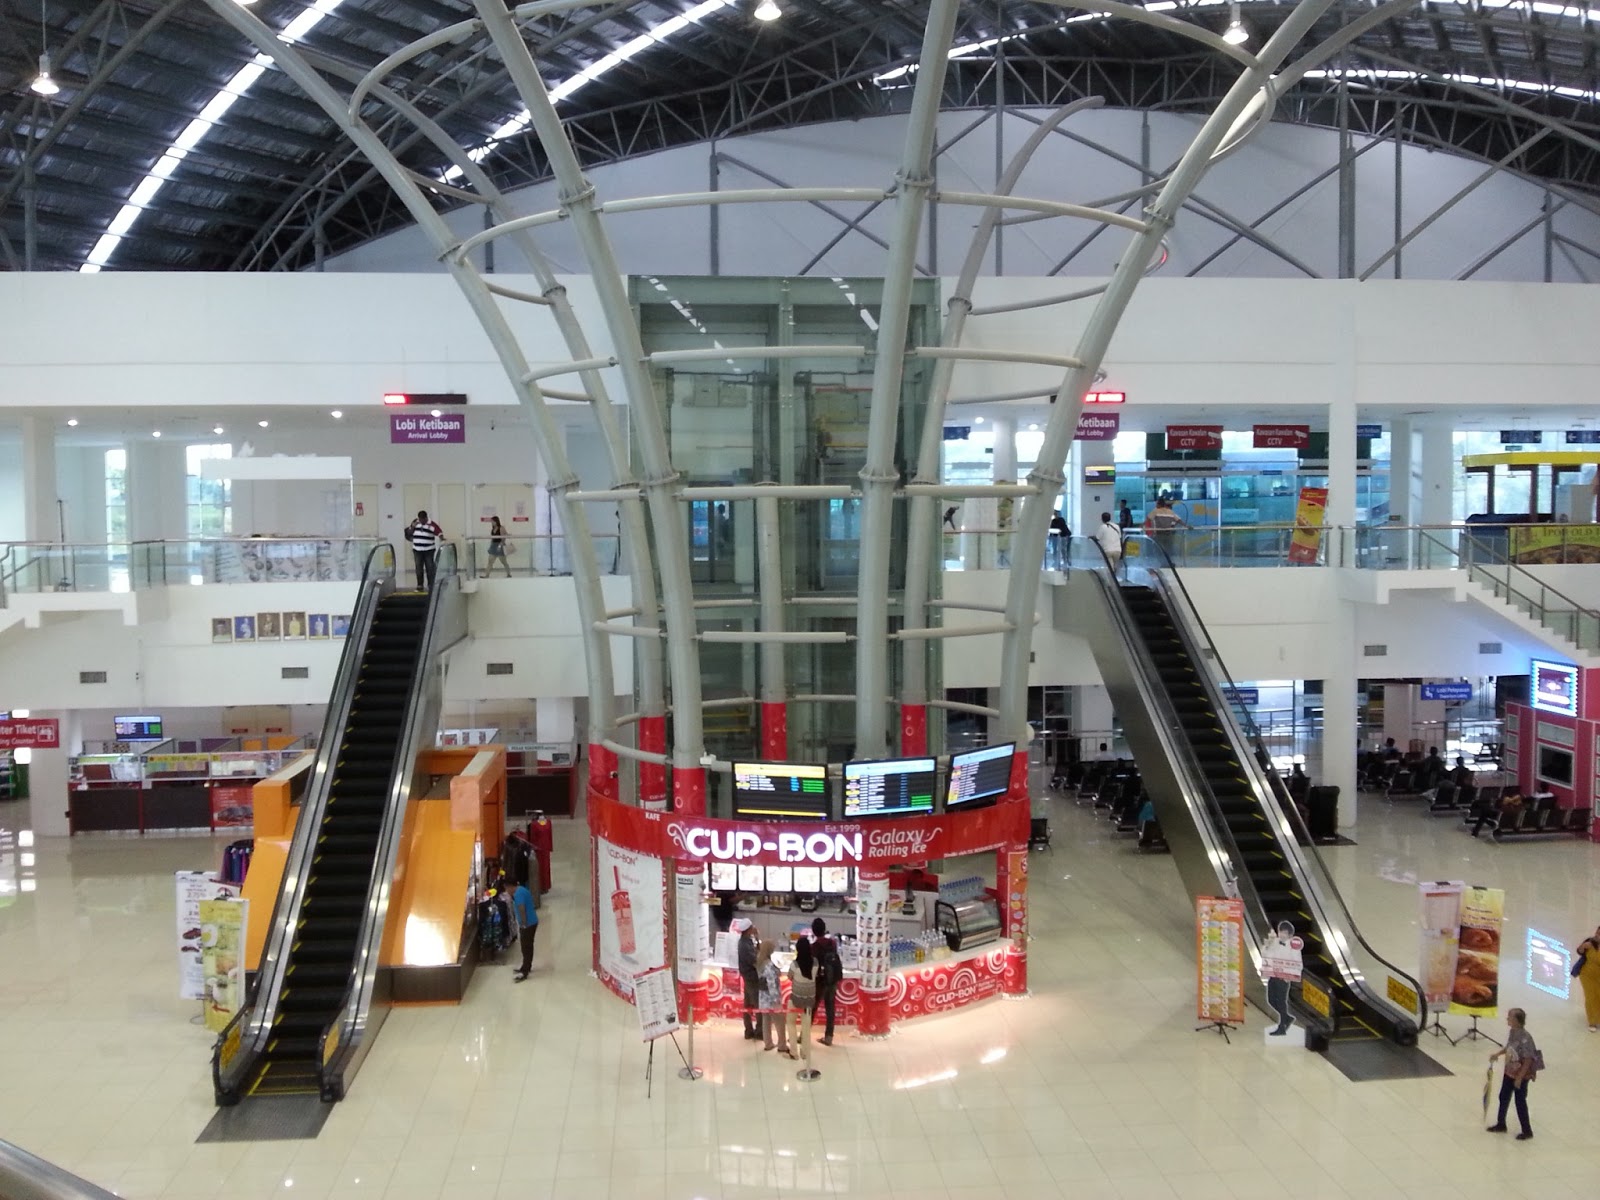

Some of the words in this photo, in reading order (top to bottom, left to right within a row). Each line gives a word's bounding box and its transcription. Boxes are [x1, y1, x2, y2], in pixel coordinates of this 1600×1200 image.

[395, 419, 416, 430] Lobi
[420, 418, 460, 430] Ketibaan
[1078, 417, 1116, 428] Ketibaan
[429, 432, 448, 440] Lobby
[1180, 438, 1196, 446] CCTV
[15, 725, 37, 735] Tiket
[645, 812, 660, 821] KAFE
[868, 828, 924, 846] Galaxy
[868, 845, 908, 858] Rolling
[911, 842, 927, 854] Ice
[935, 985, 976, 1004] CUP-BON
